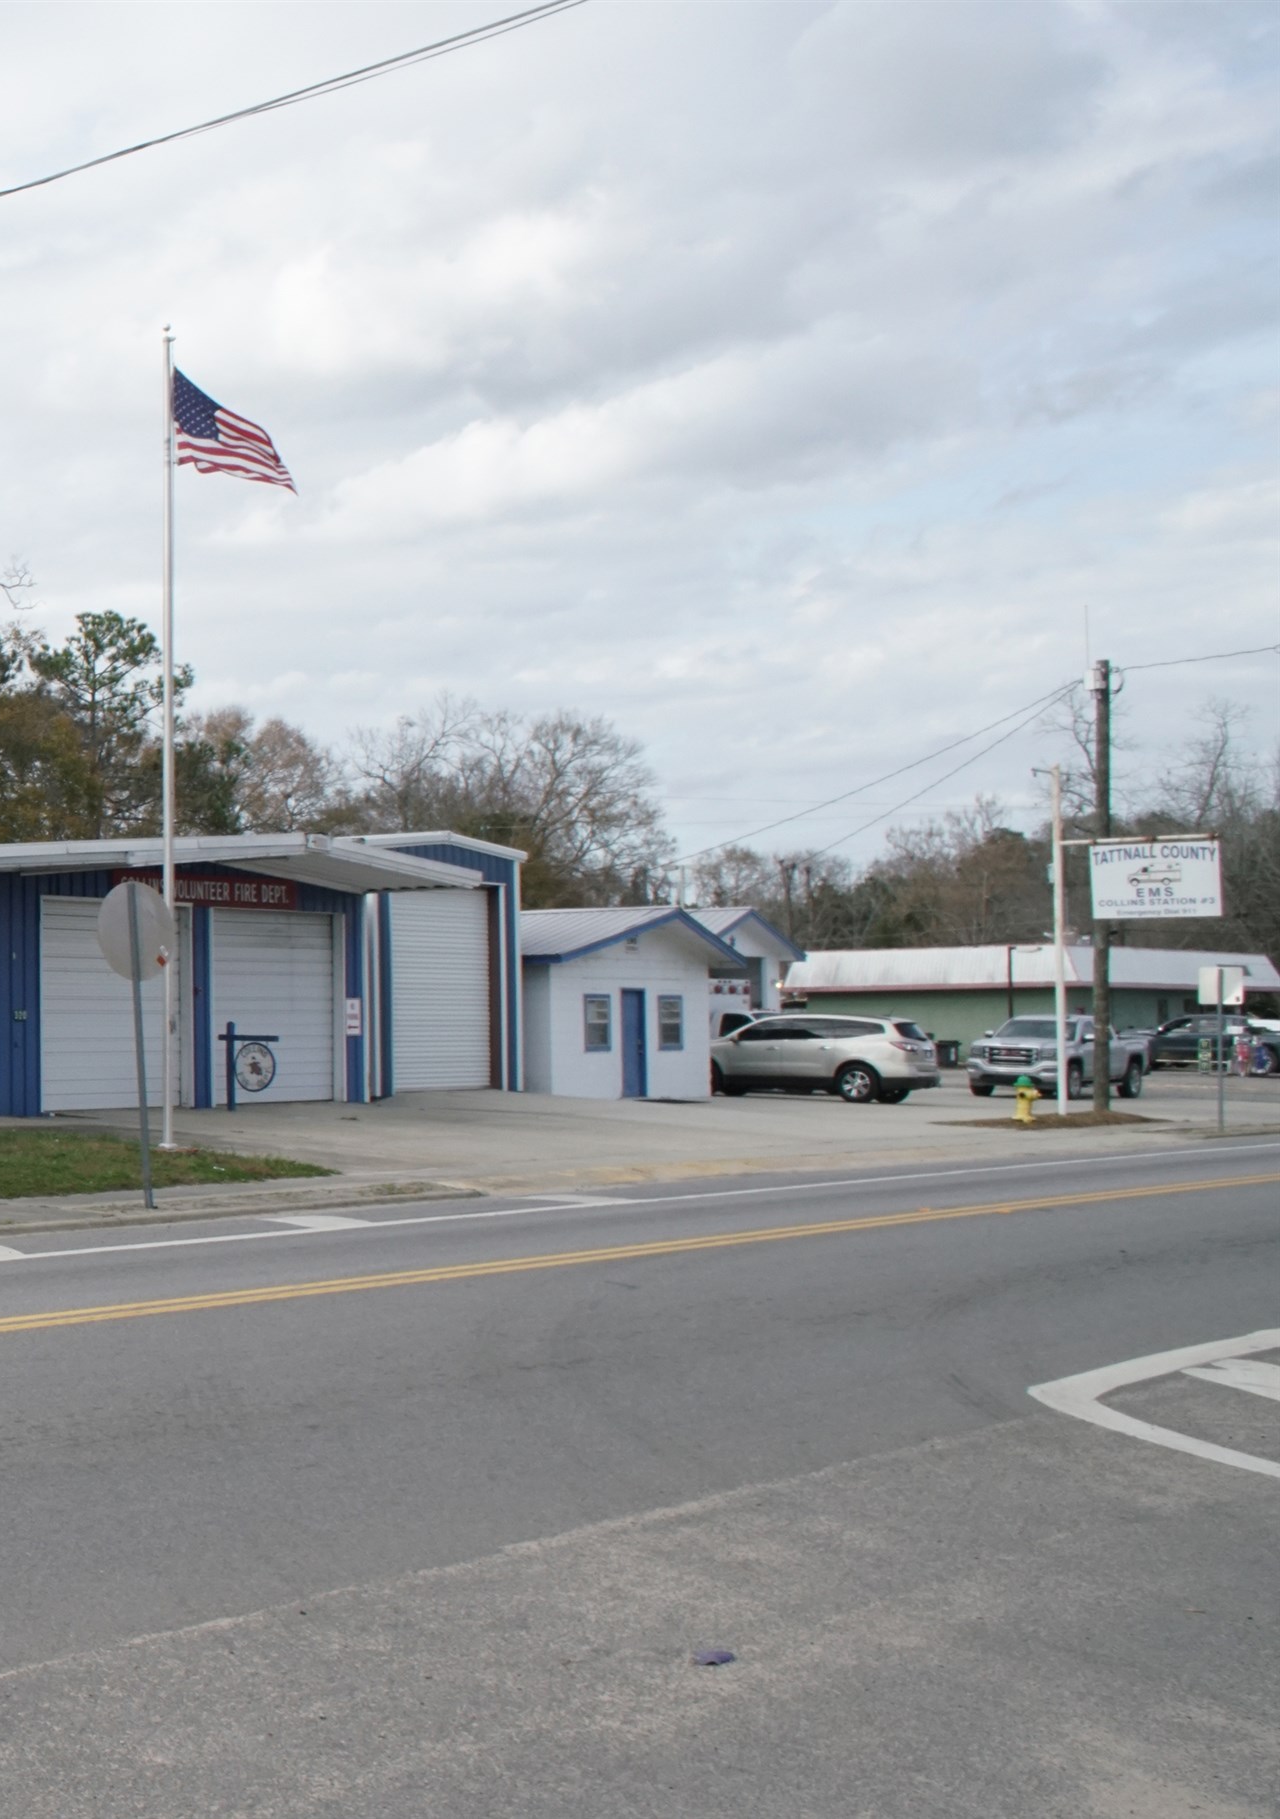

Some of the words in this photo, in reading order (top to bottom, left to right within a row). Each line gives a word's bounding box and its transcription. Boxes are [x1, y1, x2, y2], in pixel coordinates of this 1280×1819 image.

[1092, 846, 1157, 866] TATTNALL
[1160, 845, 1217, 861] COUNTY
[173, 878, 230, 901] VOLUNTEER
[234, 884, 257, 903] FIRE
[261, 885, 290, 904] DEPT.
[1098, 898, 1146, 907] COLLINS
[1149, 897, 1197, 906] STATION
[1200, 896, 1216, 905] #3
